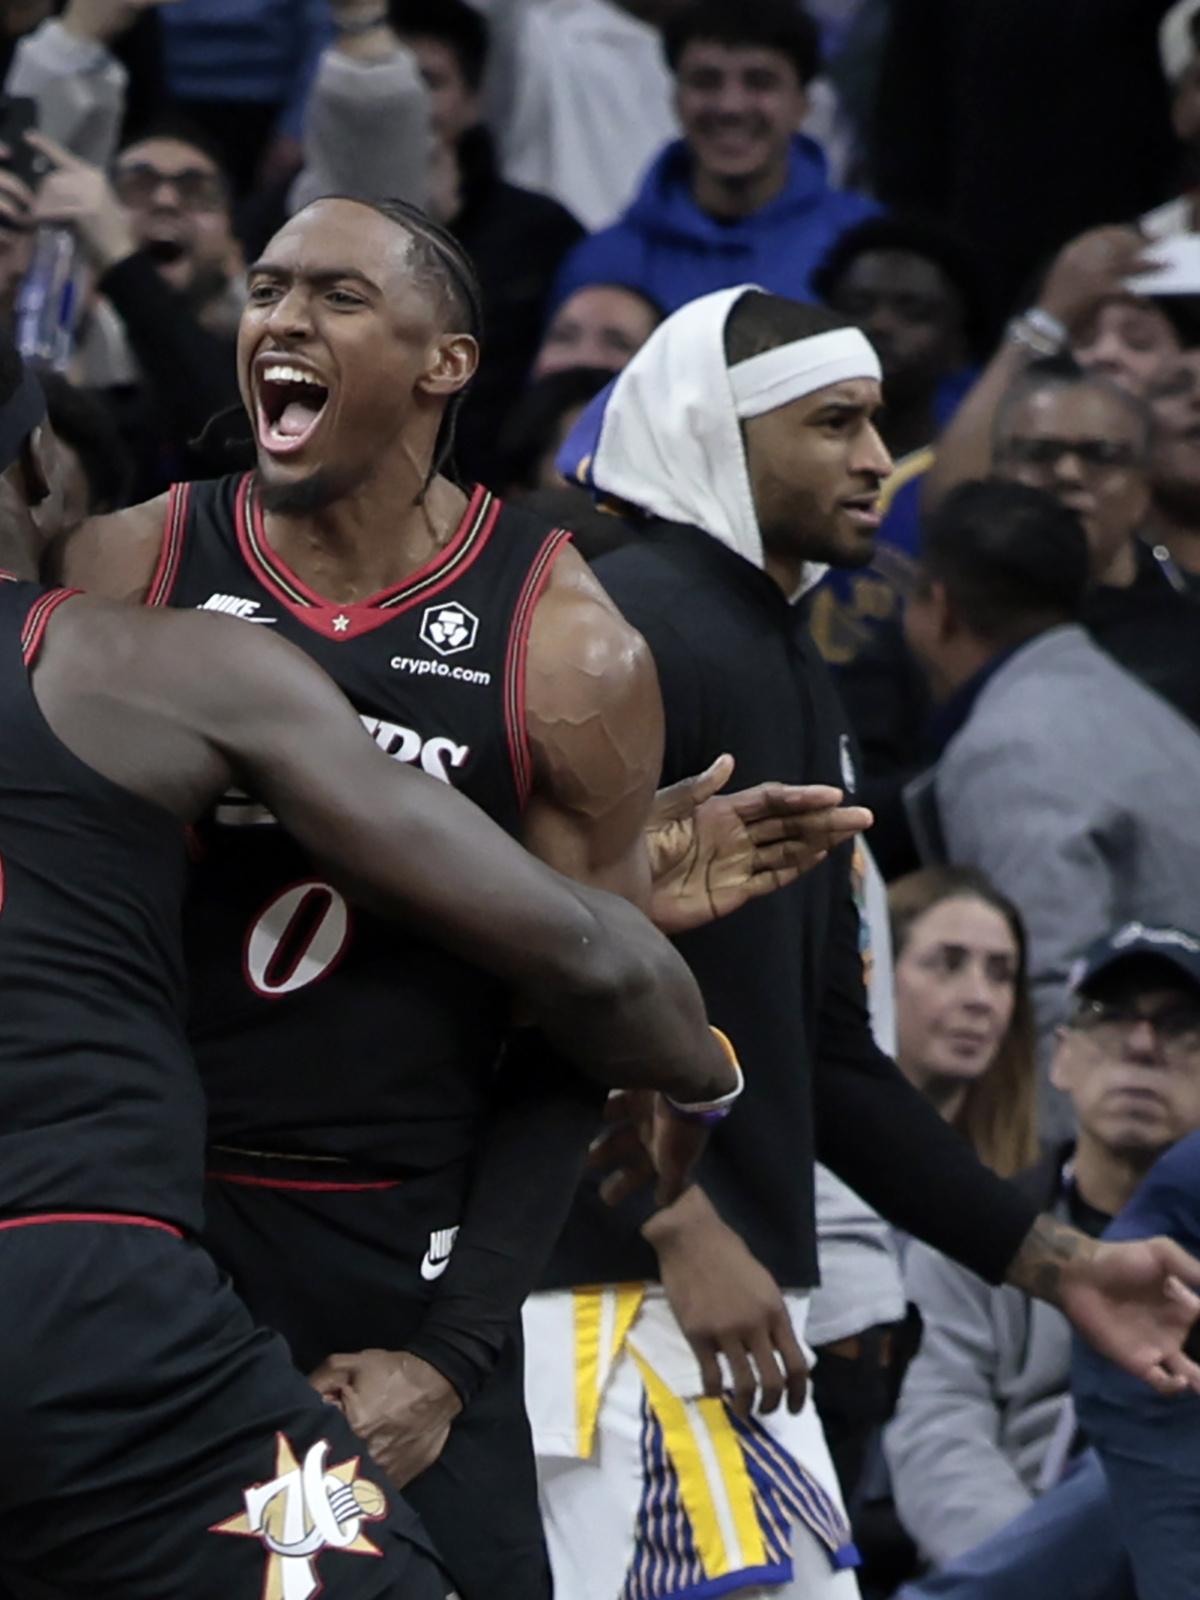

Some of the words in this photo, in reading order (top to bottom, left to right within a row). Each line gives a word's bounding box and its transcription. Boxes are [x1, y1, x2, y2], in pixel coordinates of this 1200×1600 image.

[203, 593, 261, 618] NIKE
[390, 655, 491, 685] crypto.com
[242, 877, 353, 998] 0
